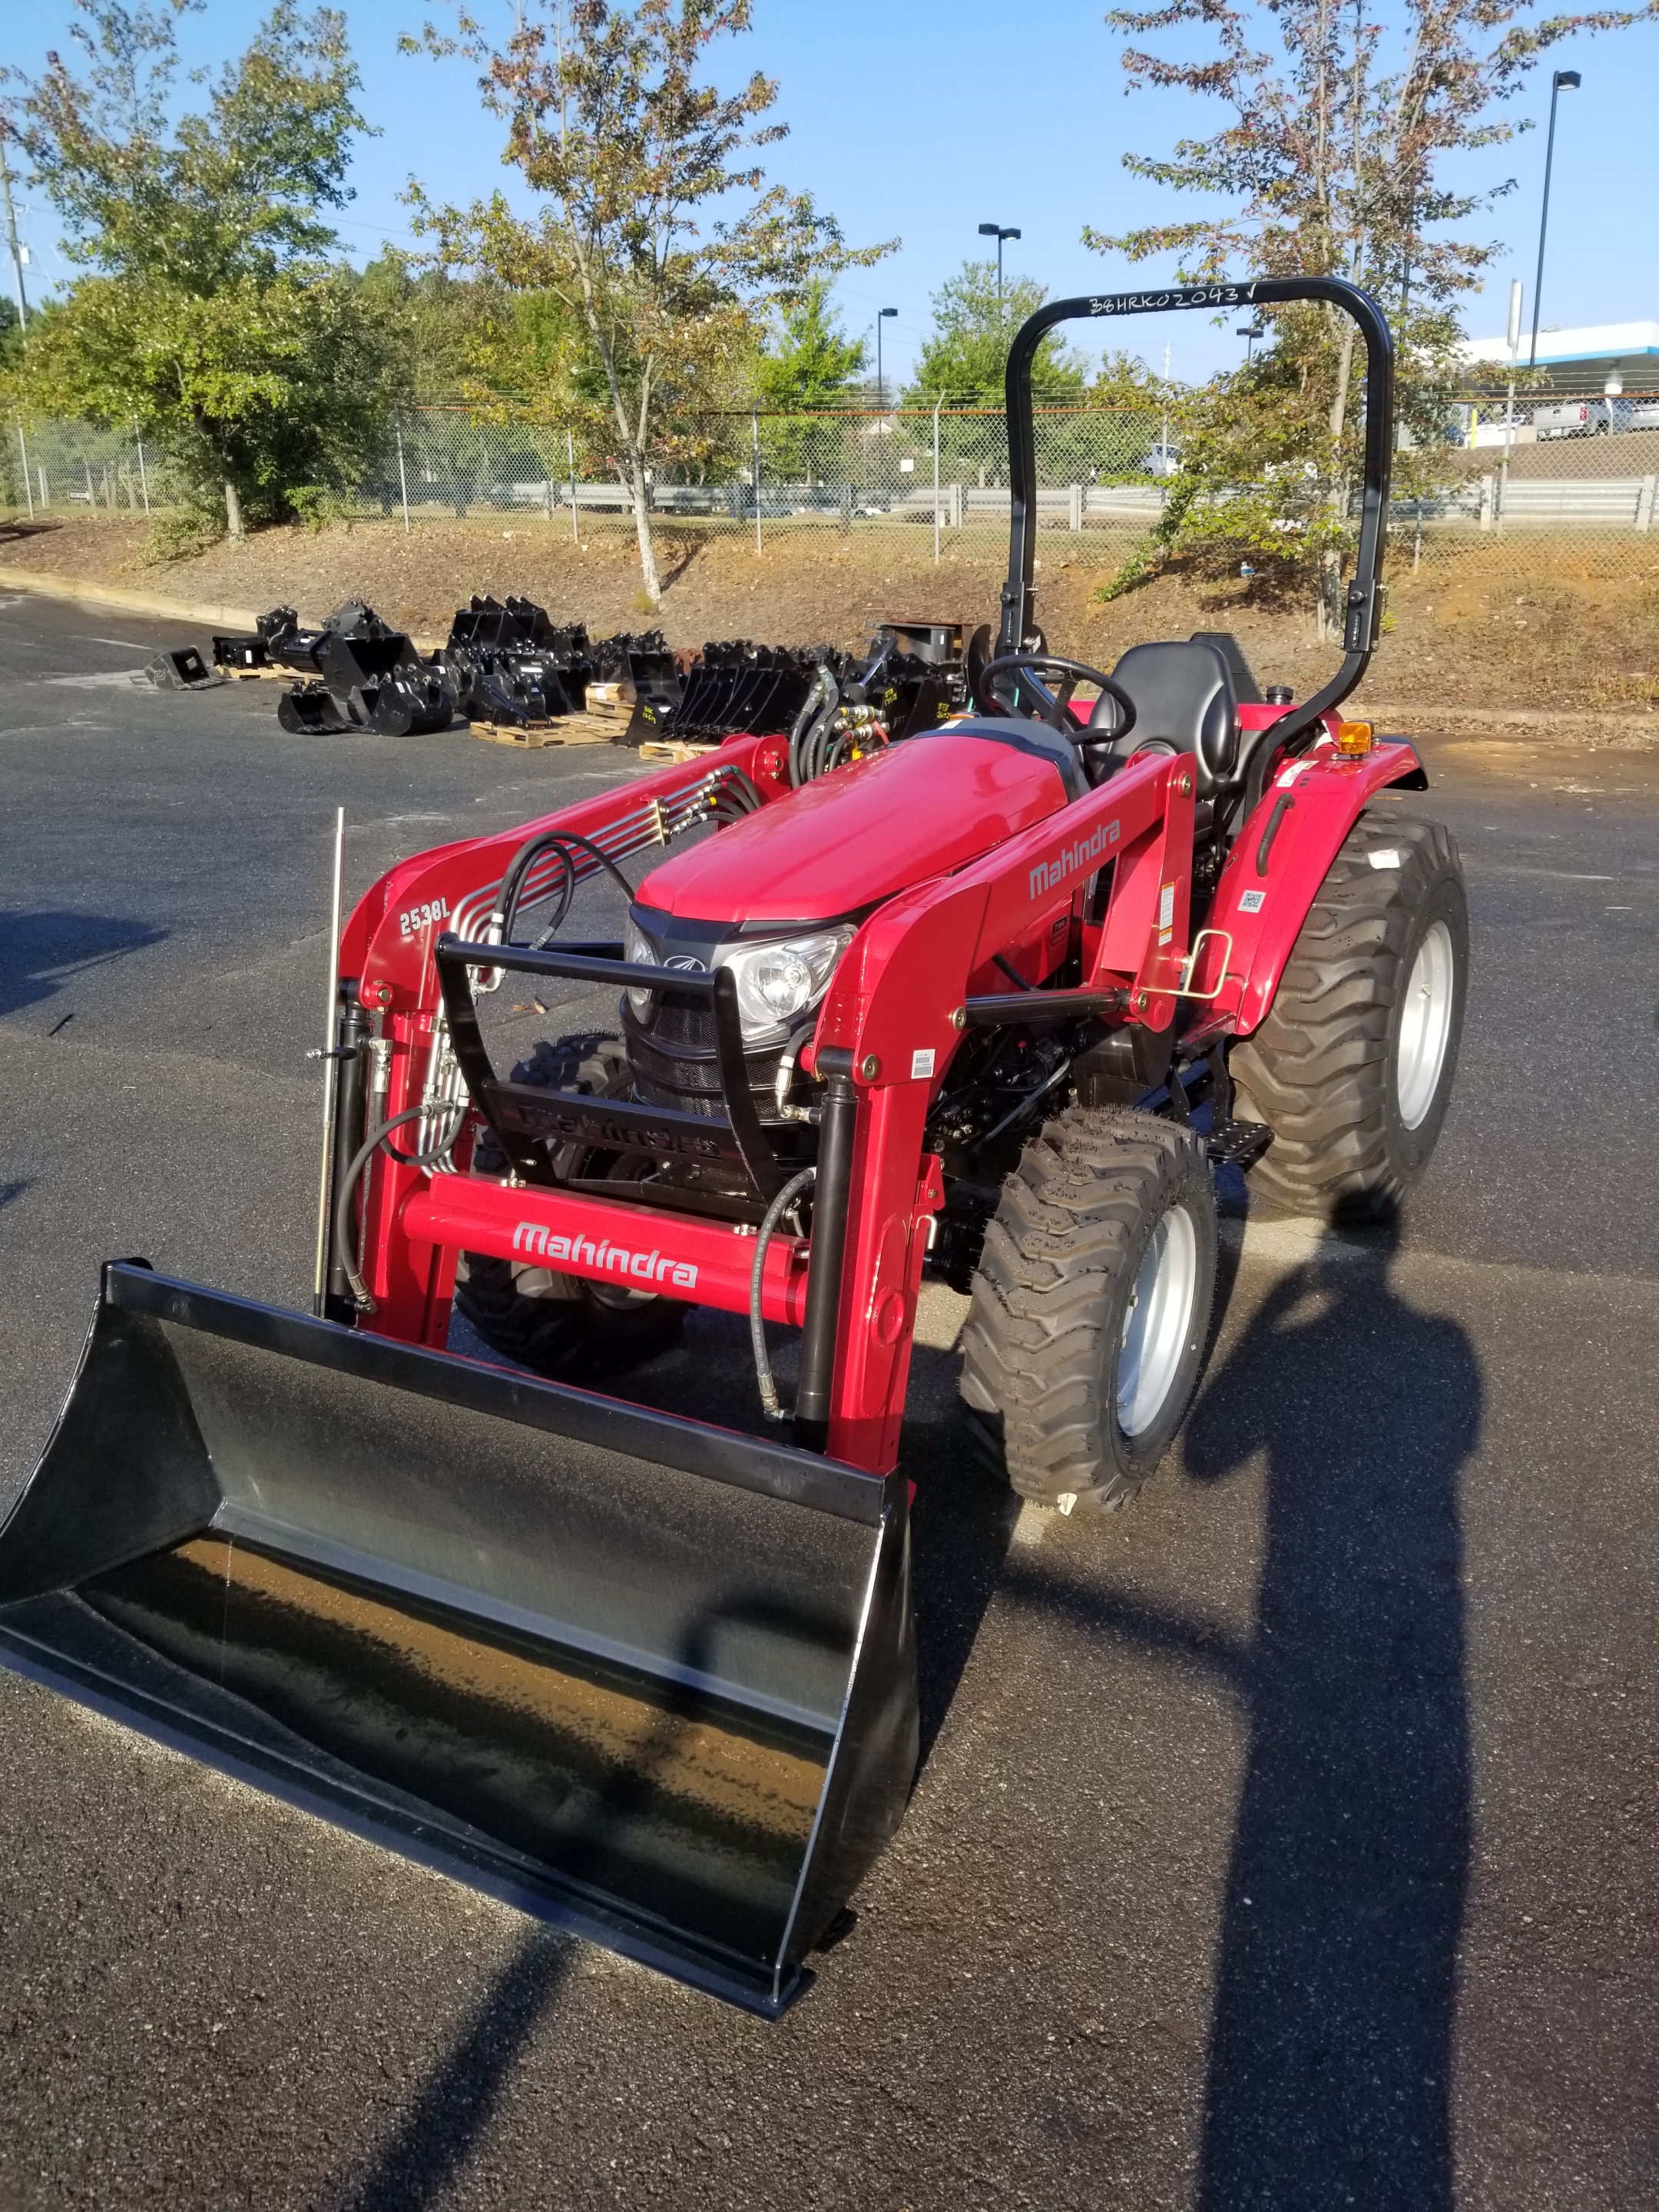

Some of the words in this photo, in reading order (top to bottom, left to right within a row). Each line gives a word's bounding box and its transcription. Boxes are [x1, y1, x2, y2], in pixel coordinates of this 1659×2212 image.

[1029, 819, 1120, 900] Mahindra
[399, 896, 451, 935] 2538L
[513, 1221, 698, 1289] Mahindra
